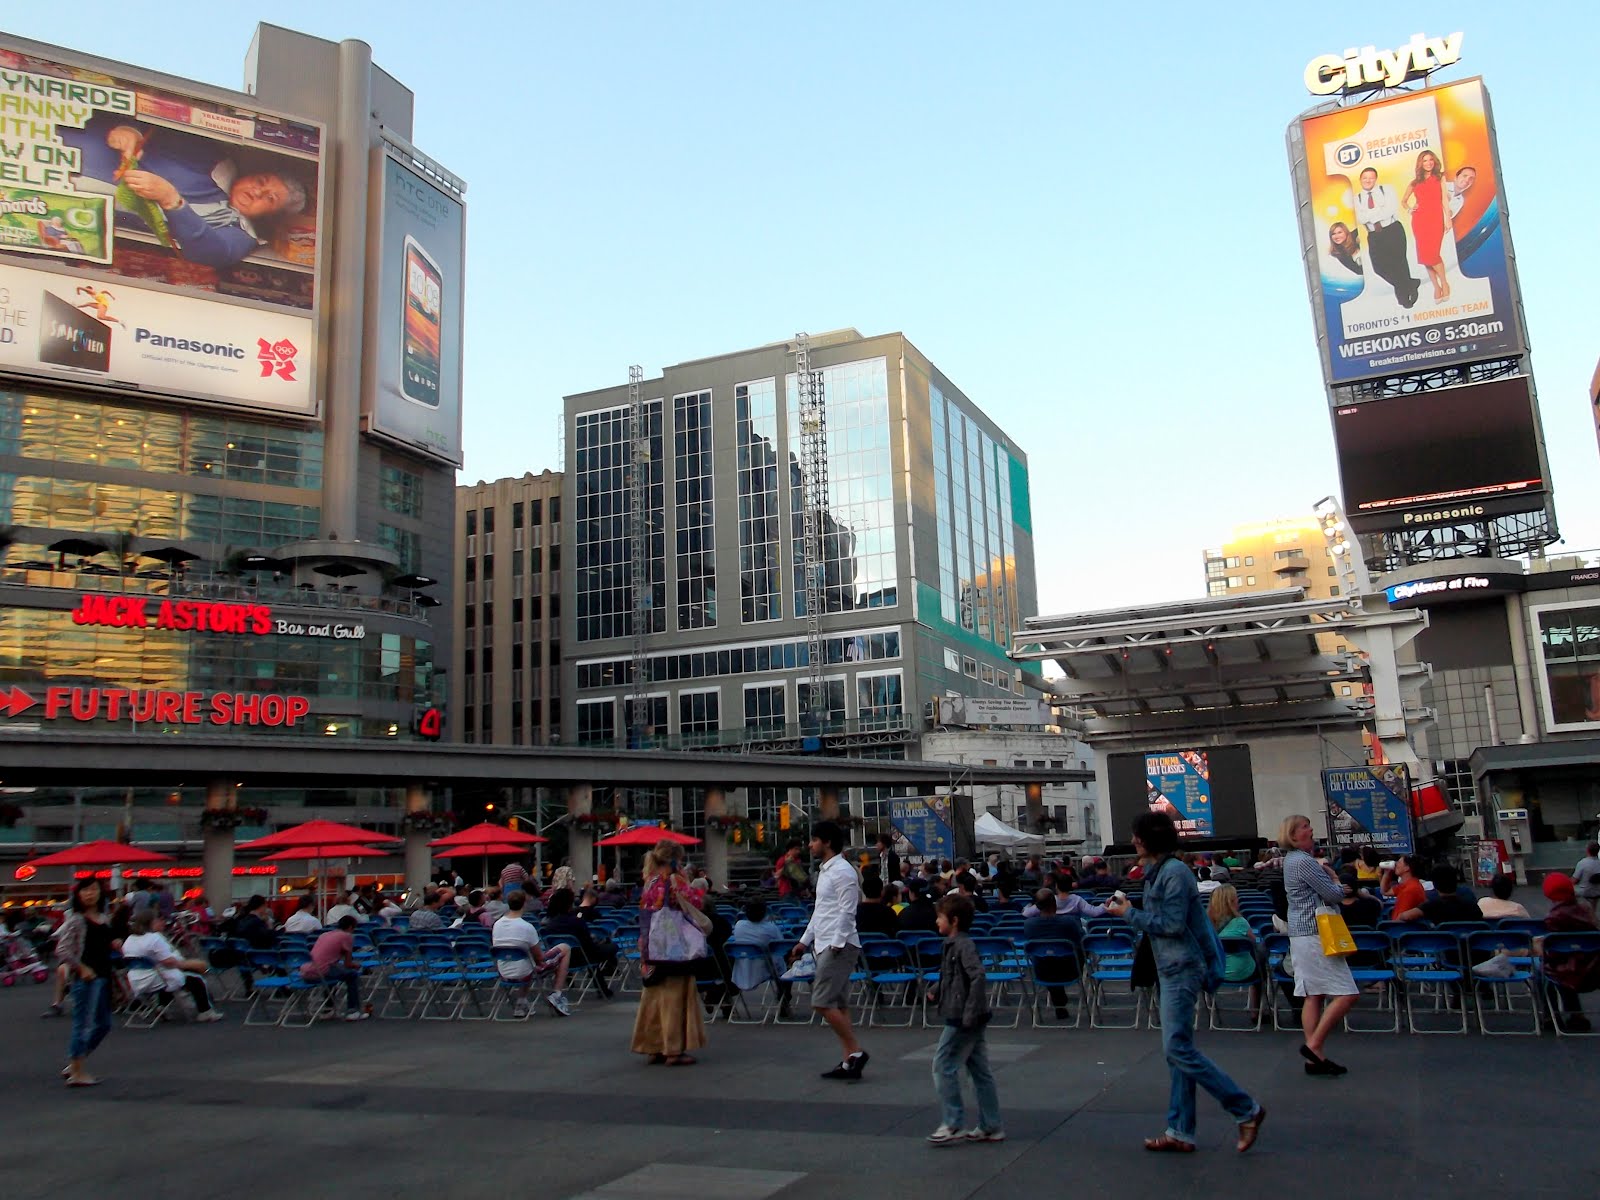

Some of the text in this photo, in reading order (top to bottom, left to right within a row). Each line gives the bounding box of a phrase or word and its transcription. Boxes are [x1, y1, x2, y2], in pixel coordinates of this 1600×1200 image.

[1304, 32, 1464, 95] Citytv
[33, 144, 75, 168] ON
[1338, 128, 1427, 163] BT BREAKFAST
[1368, 139, 1429, 159] TELEVISION
[1347, 317, 1399, 333] TORONTO'S
[1413, 307, 1459, 322] MORNING
[1462, 301, 1489, 313] TEAM
[135, 327, 245, 359] Panasonic
[1339, 320, 1504, 358] WEEKDAYS @ 5:30am
[1369, 347, 1456, 367] BreakfastTelevision.ca
[1403, 505, 1484, 524] Panasonic
[1394, 577, 1489, 598] CityNews at Five
[72, 594, 365, 639] JACK ASTOR'S Bar and Grill
[45, 686, 309, 727] FUTURE SHOP
[1147, 757, 1180, 767] CITY CINEMA
[1147, 764, 1186, 776] CULT CLASSICS
[1330, 772, 1368, 781] CITY CINEMA
[1330, 780, 1376, 791] CULT CLASSICS
[906, 808, 929, 818] CLASSICS
